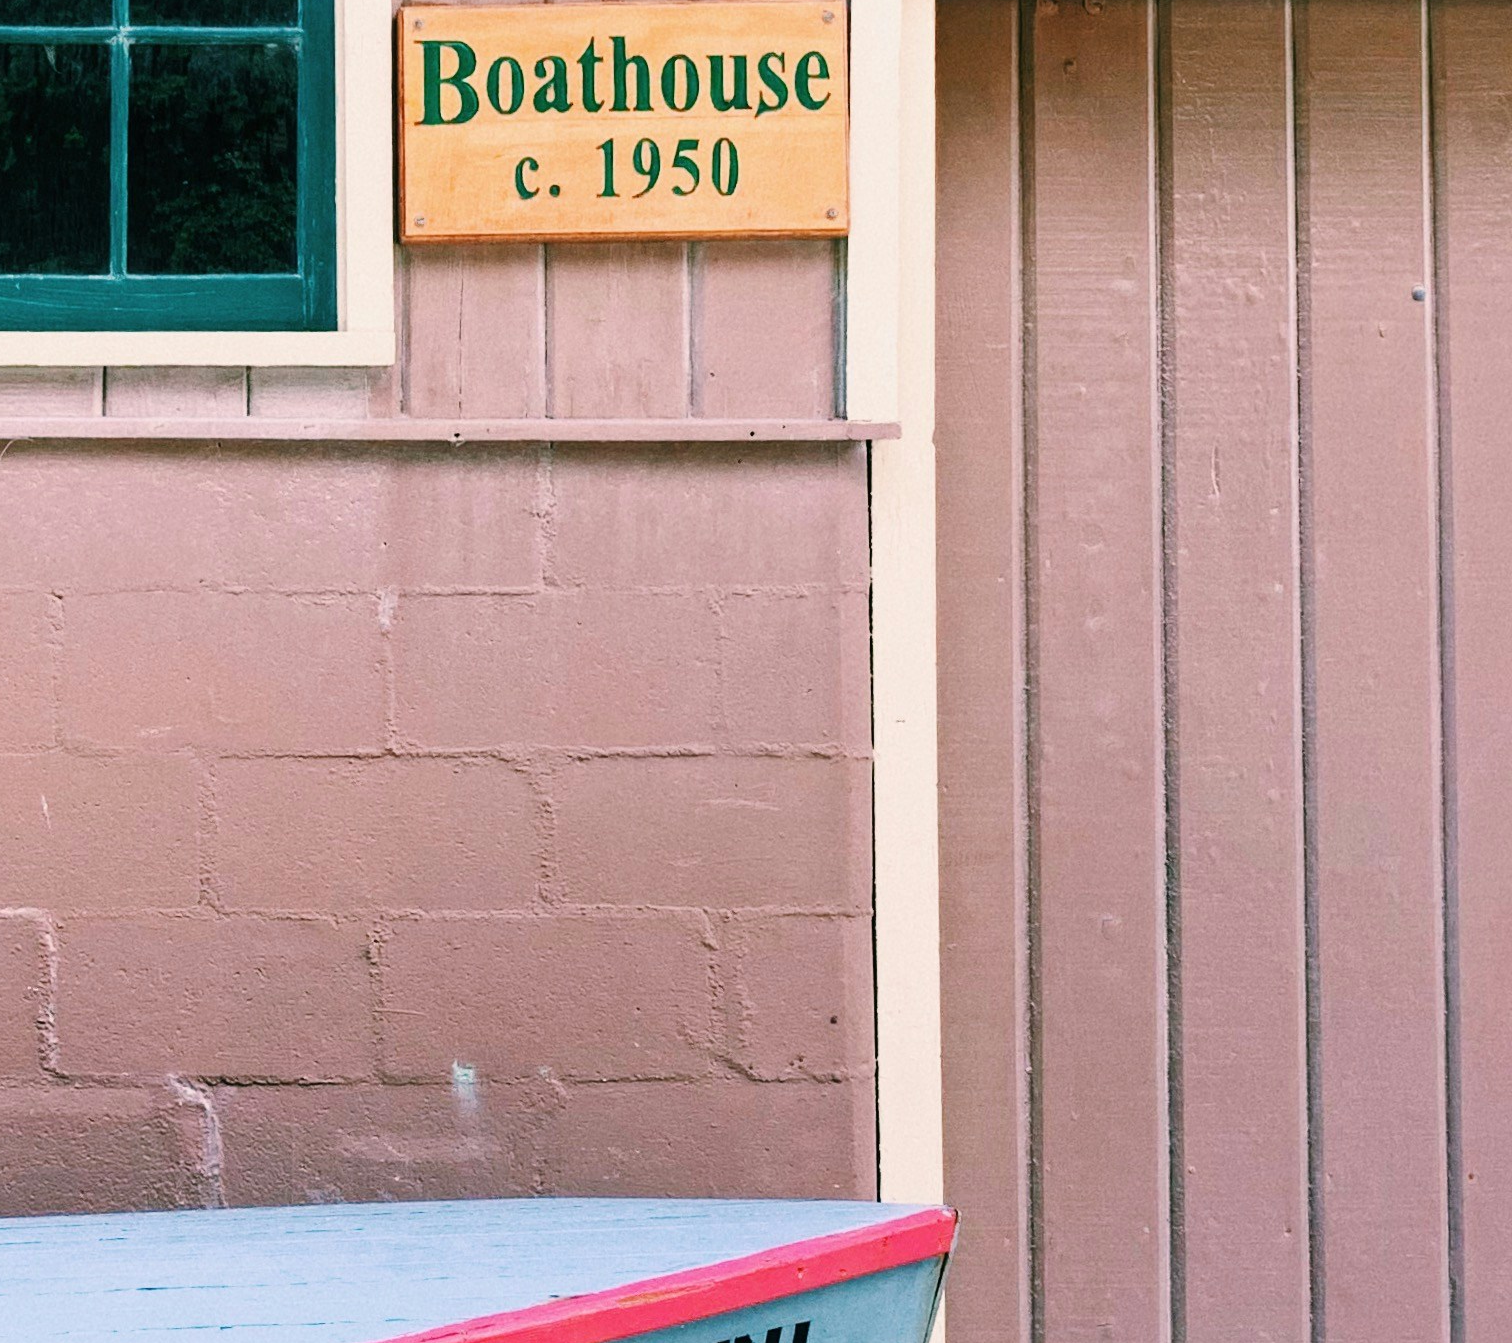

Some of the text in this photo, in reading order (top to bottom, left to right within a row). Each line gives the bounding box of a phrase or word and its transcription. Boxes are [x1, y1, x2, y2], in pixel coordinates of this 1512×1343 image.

[413, 35, 832, 127] Boathouse
[514, 137, 740, 201] c. 1950
